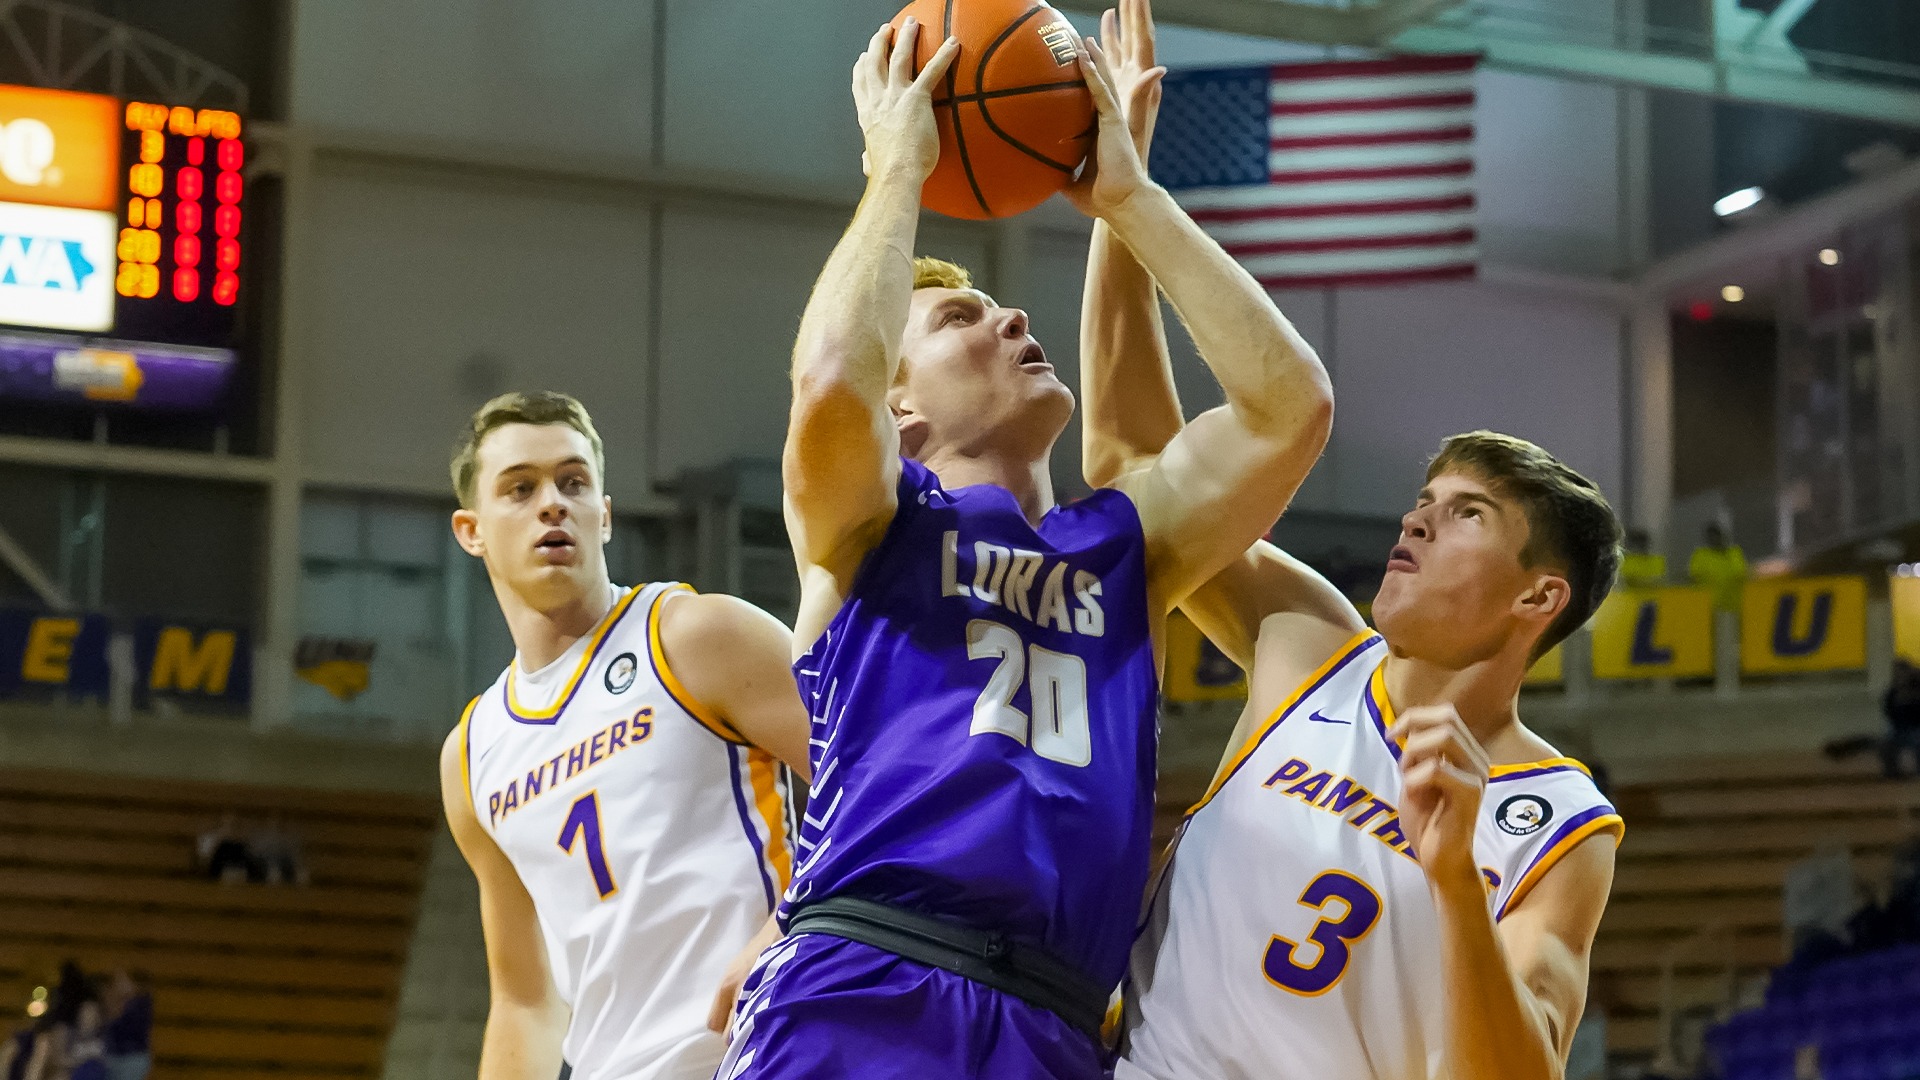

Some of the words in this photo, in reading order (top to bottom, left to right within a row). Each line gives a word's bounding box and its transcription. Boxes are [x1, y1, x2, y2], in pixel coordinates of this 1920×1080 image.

[941, 530, 1105, 637] LORAS
[1630, 601, 1674, 666] L
[1772, 589, 1833, 658] U
[21, 617, 81, 683] E
[151, 626, 237, 696] M
[965, 618, 1092, 768] 20
[488, 705, 655, 832] PANTHERS
[556, 788, 619, 902] 1
[1261, 756, 1501, 893] PANTH
[1261, 868, 1384, 998] 3
